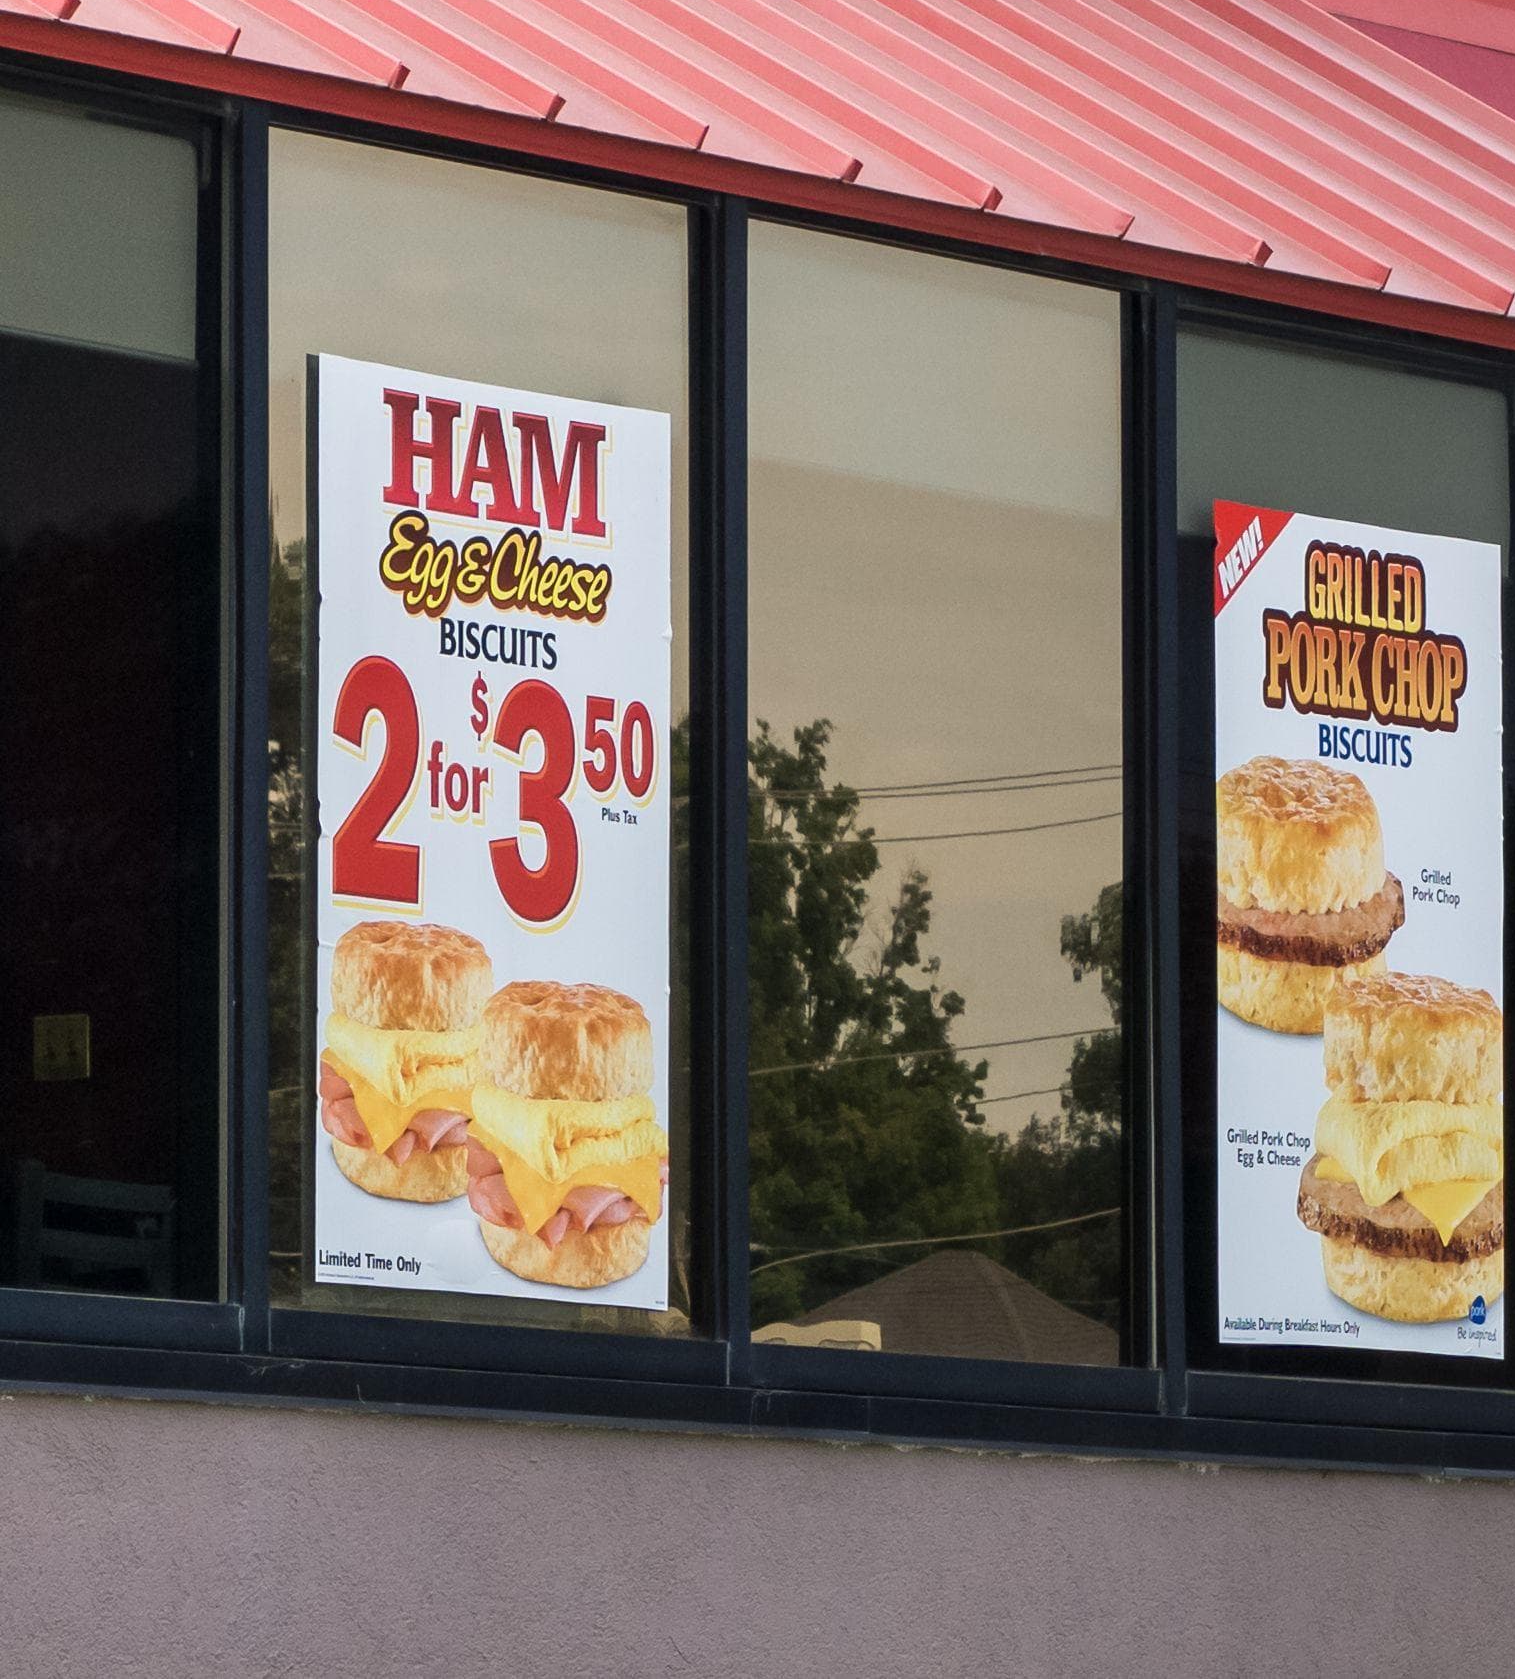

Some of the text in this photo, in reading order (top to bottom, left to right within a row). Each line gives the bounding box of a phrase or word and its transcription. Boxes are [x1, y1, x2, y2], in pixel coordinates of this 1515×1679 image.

[383, 387, 606, 538] HAM
[380, 512, 610, 618] Egg & Cheese
[1218, 516, 1264, 599] NEW!
[1309, 549, 1422, 633] GRILLED
[439, 618, 558, 670] BISCUITS
[1267, 618, 1464, 723] PORK CHOP
[1318, 723, 1413, 768] BISCUITS
[332, 655, 420, 904] 2
[428, 740, 489, 813] for
[601, 808, 638, 825] Plus Tax
[1421, 869, 1451, 885] Grilled
[1413, 887, 1460, 909] Pork Chop
[1227, 1128, 1310, 1151] Grilled Pork Chop
[1237, 1148, 1301, 1168] Egg & Cheese
[319, 1249, 421, 1275] Limited Time Only
[1224, 1317, 1360, 1338] Available During Breakfast Hours Only
[1457, 1327, 1497, 1348] Be inspired
